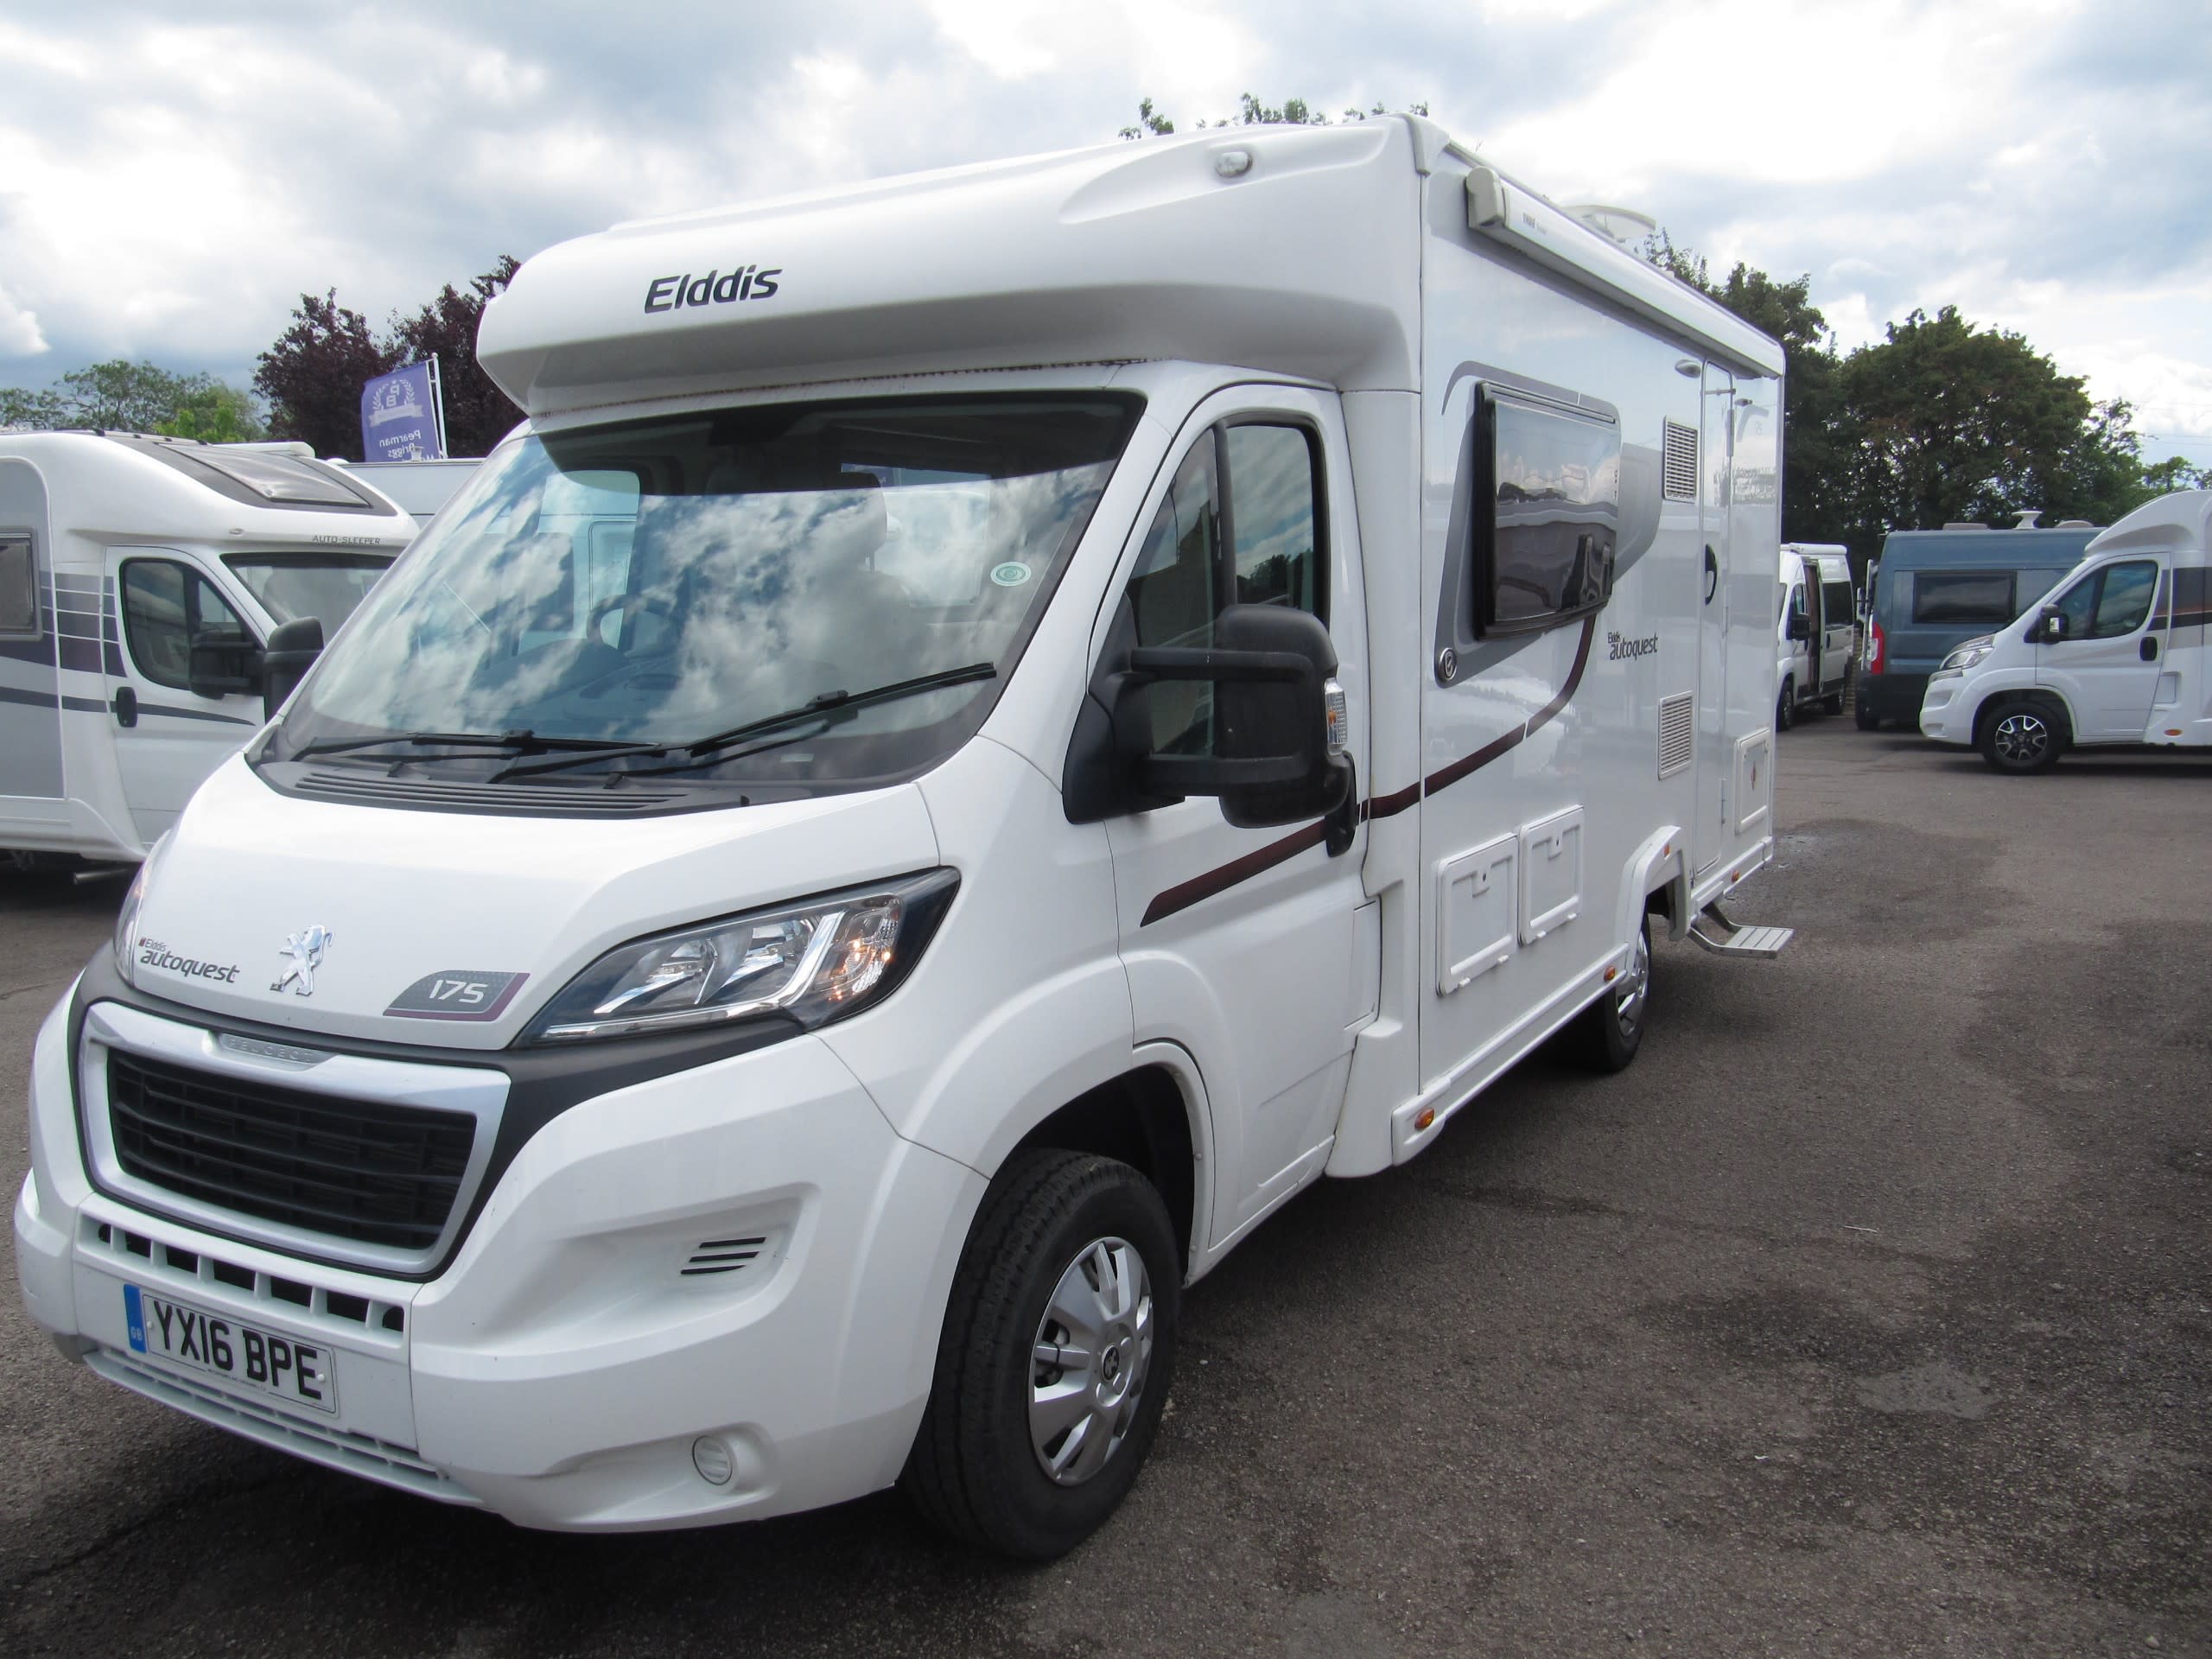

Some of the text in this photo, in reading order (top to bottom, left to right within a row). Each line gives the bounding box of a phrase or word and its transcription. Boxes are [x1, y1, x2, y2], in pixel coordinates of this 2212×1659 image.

[645, 264, 783, 314] Elddis
[312, 535, 380, 544] AUTO-SLEEPER
[1610, 632, 1658, 661] autoquest
[140, 950, 240, 983] autoquest
[429, 980, 488, 1003] 175
[130, 1326, 143, 1341] GB
[154, 1300, 321, 1401] YX16 BPE
